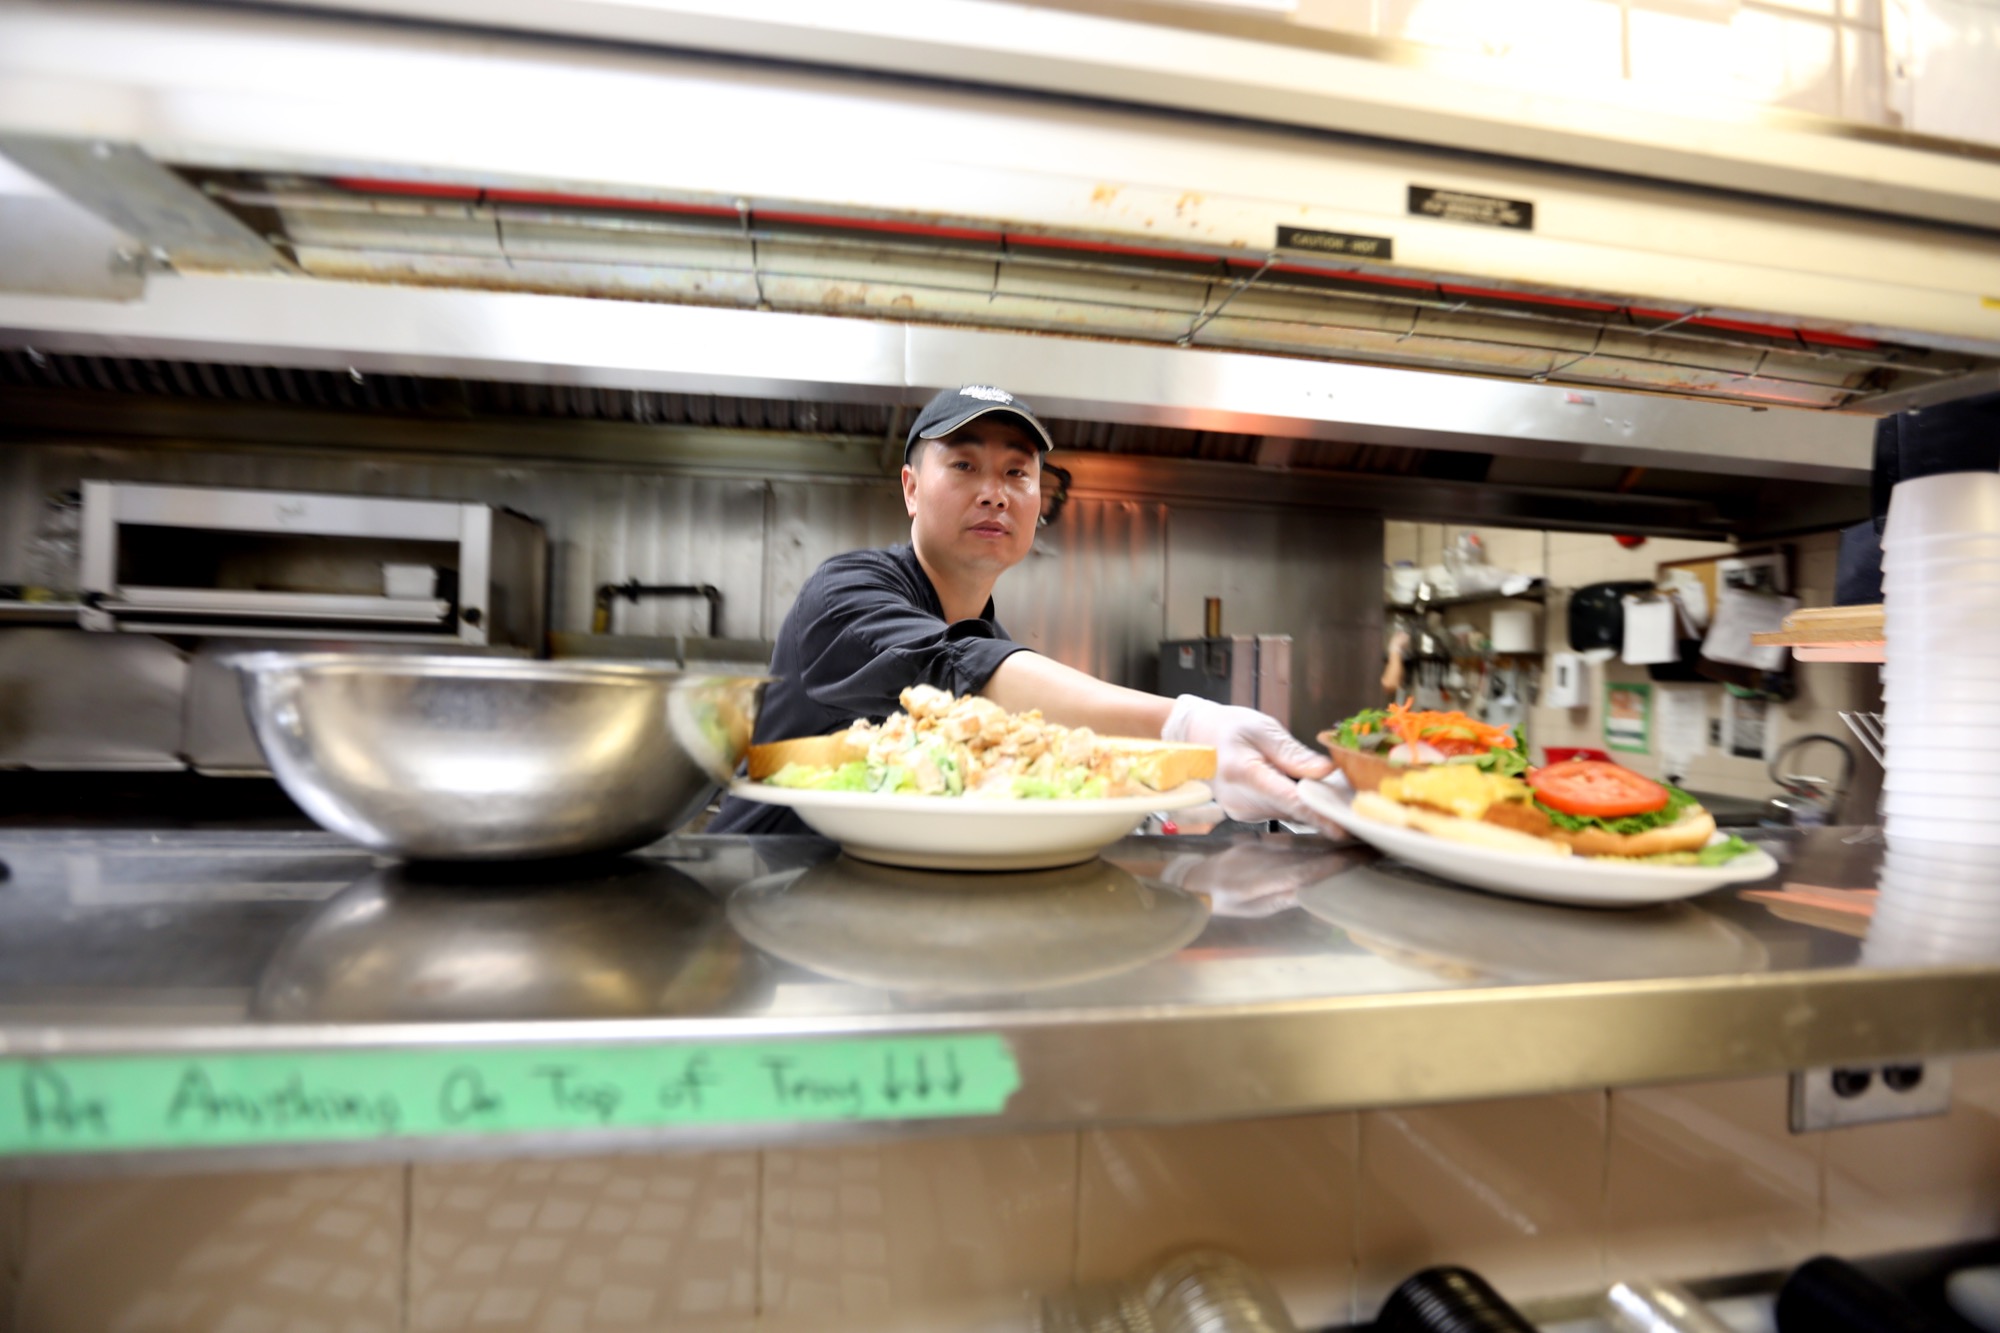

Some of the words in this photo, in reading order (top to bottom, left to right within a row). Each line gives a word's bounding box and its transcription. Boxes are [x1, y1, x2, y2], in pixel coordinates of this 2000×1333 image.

[1291, 232, 1344, 249] CAUTION
[532, 1062, 620, 1129] Top
[658, 1053, 718, 1113] of
[759, 1057, 866, 1120] Tray
